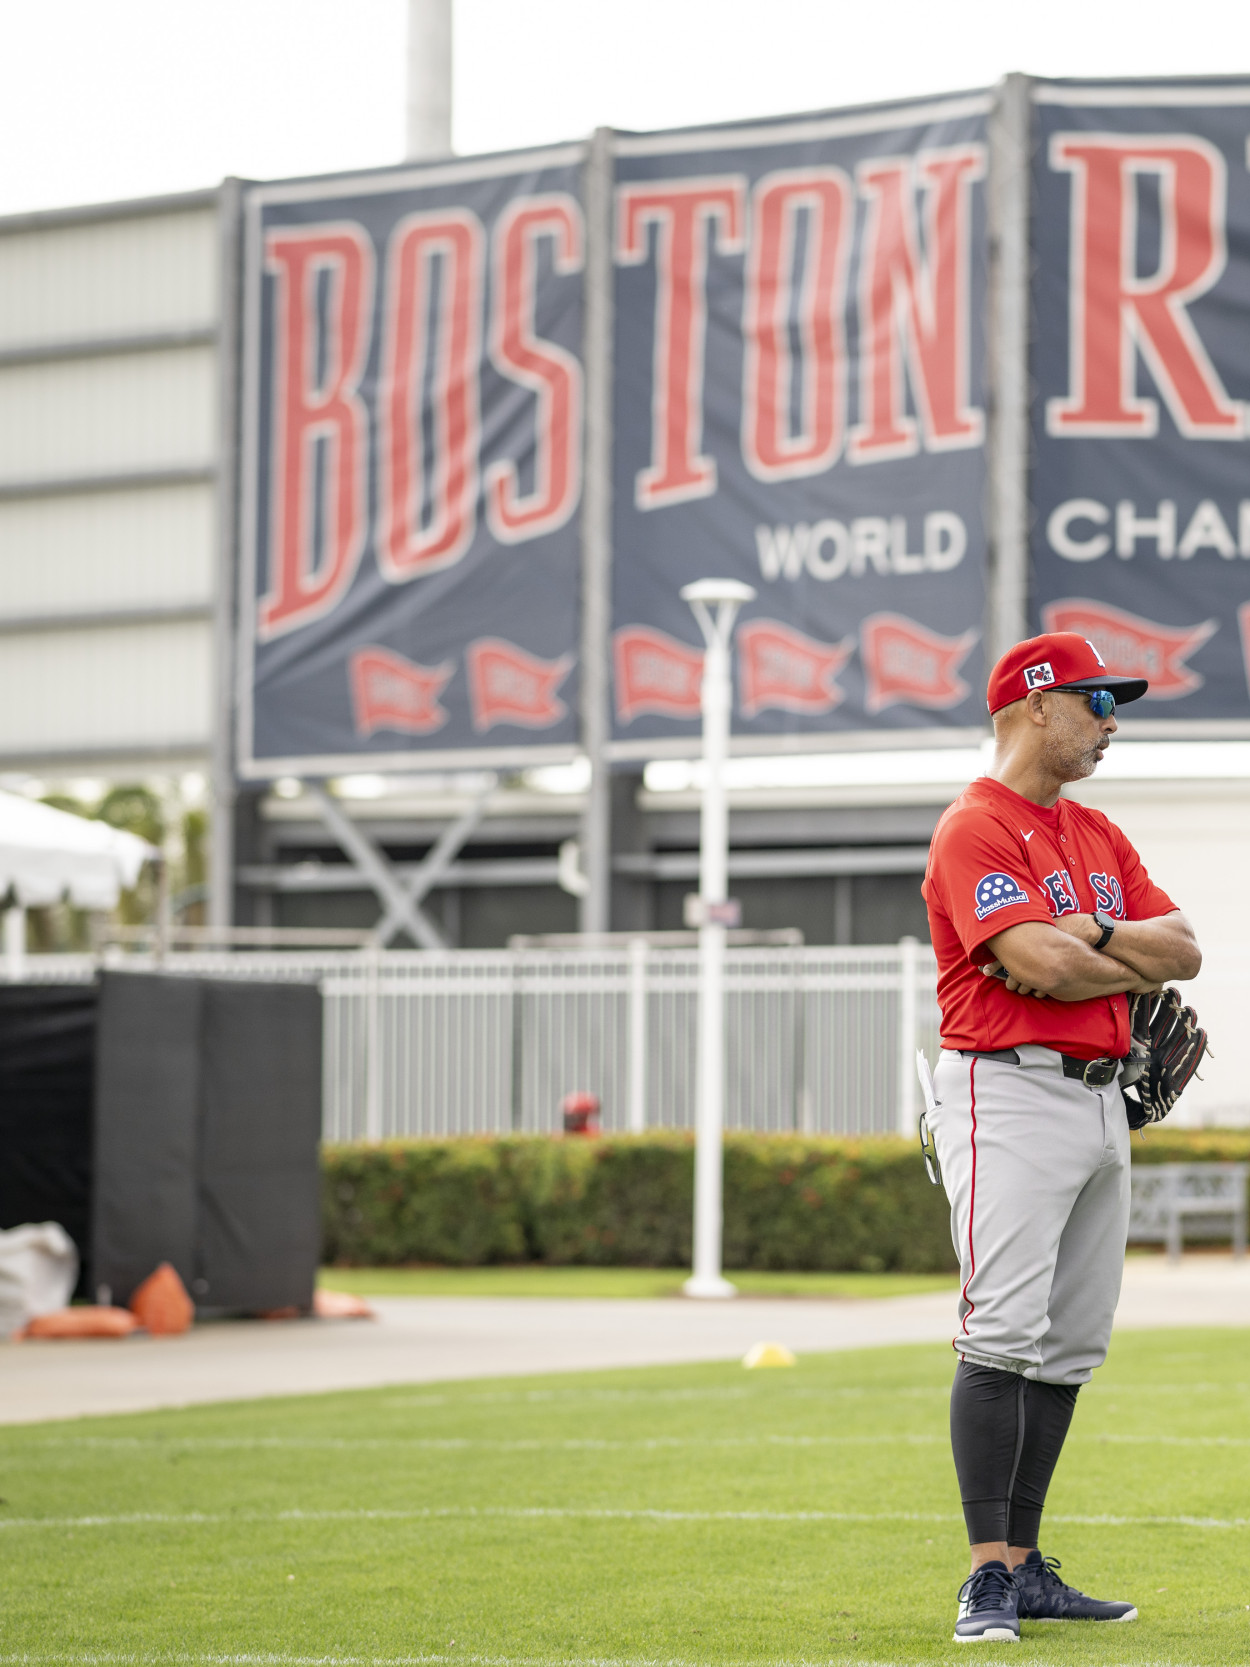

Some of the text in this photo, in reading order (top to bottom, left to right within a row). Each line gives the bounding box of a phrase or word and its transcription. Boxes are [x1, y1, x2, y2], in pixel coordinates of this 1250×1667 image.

[256, 145, 985, 641] BOSTON
[754, 508, 968, 583] WORLD
[977, 892, 1027, 917] MassMutual
[1089, 872, 1127, 920] SO
